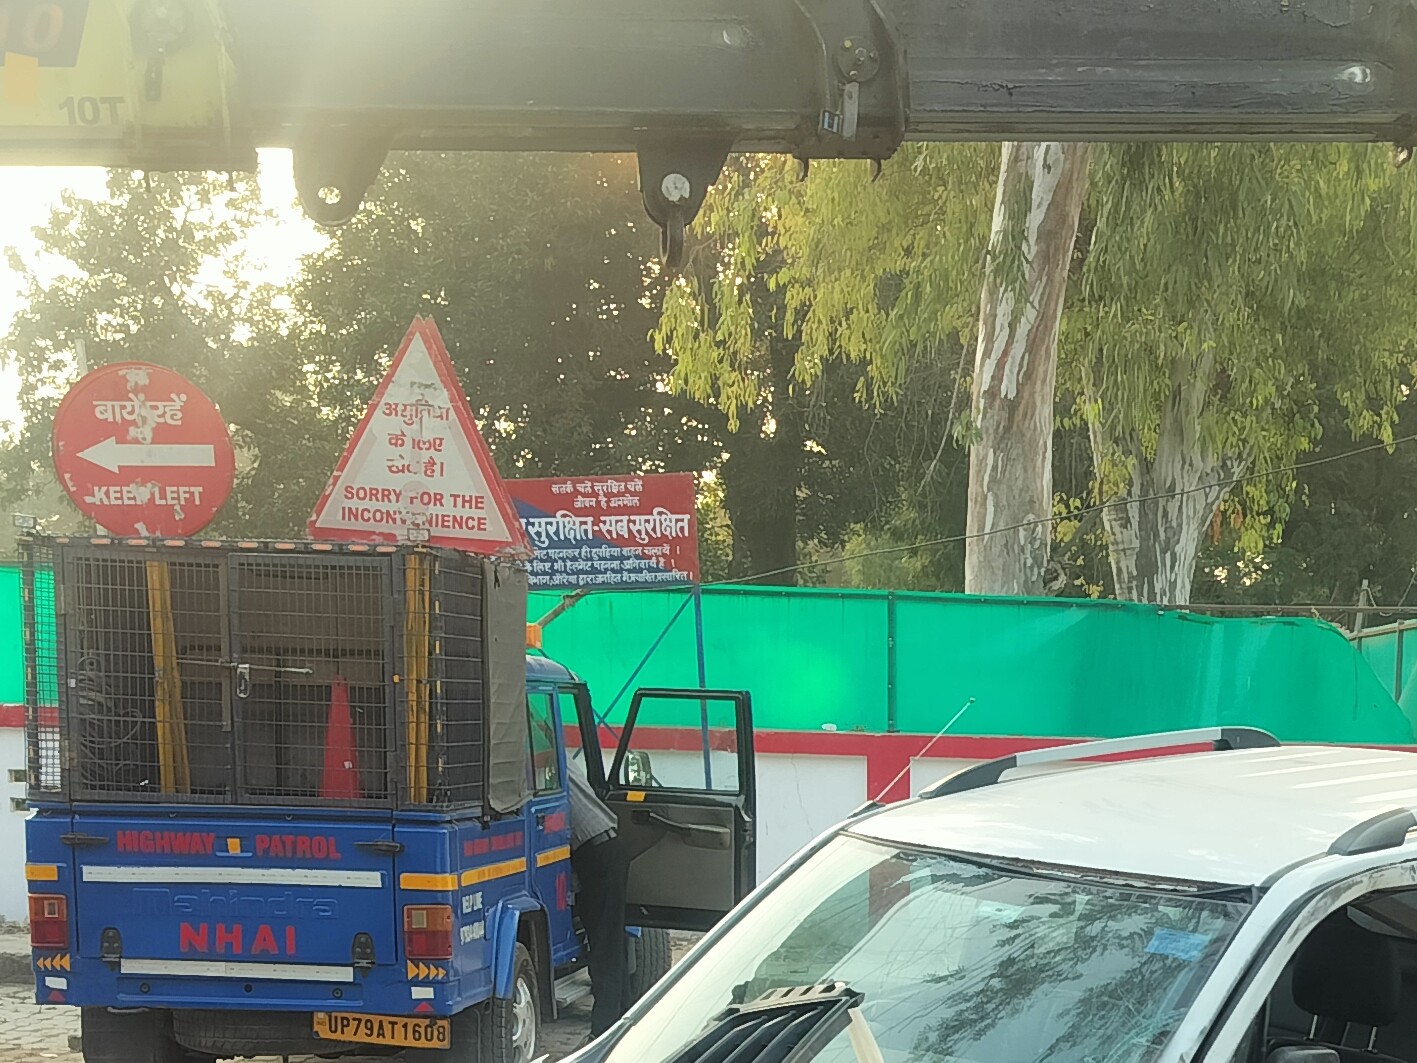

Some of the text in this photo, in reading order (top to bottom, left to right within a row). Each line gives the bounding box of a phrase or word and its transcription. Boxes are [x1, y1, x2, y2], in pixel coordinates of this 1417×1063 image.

[58, 96, 125, 126] 10T
[155, 486, 203, 506] LEFT
[344, 486, 402, 504] SORRY
[450, 494, 485, 510] THE
[629, 507, 691, 543] सुरक्षित
[117, 831, 341, 860] HIGHWAY PATROL
[179, 922, 297, 956] NHAI
[328, 1014, 447, 1043] UP79AT1608
